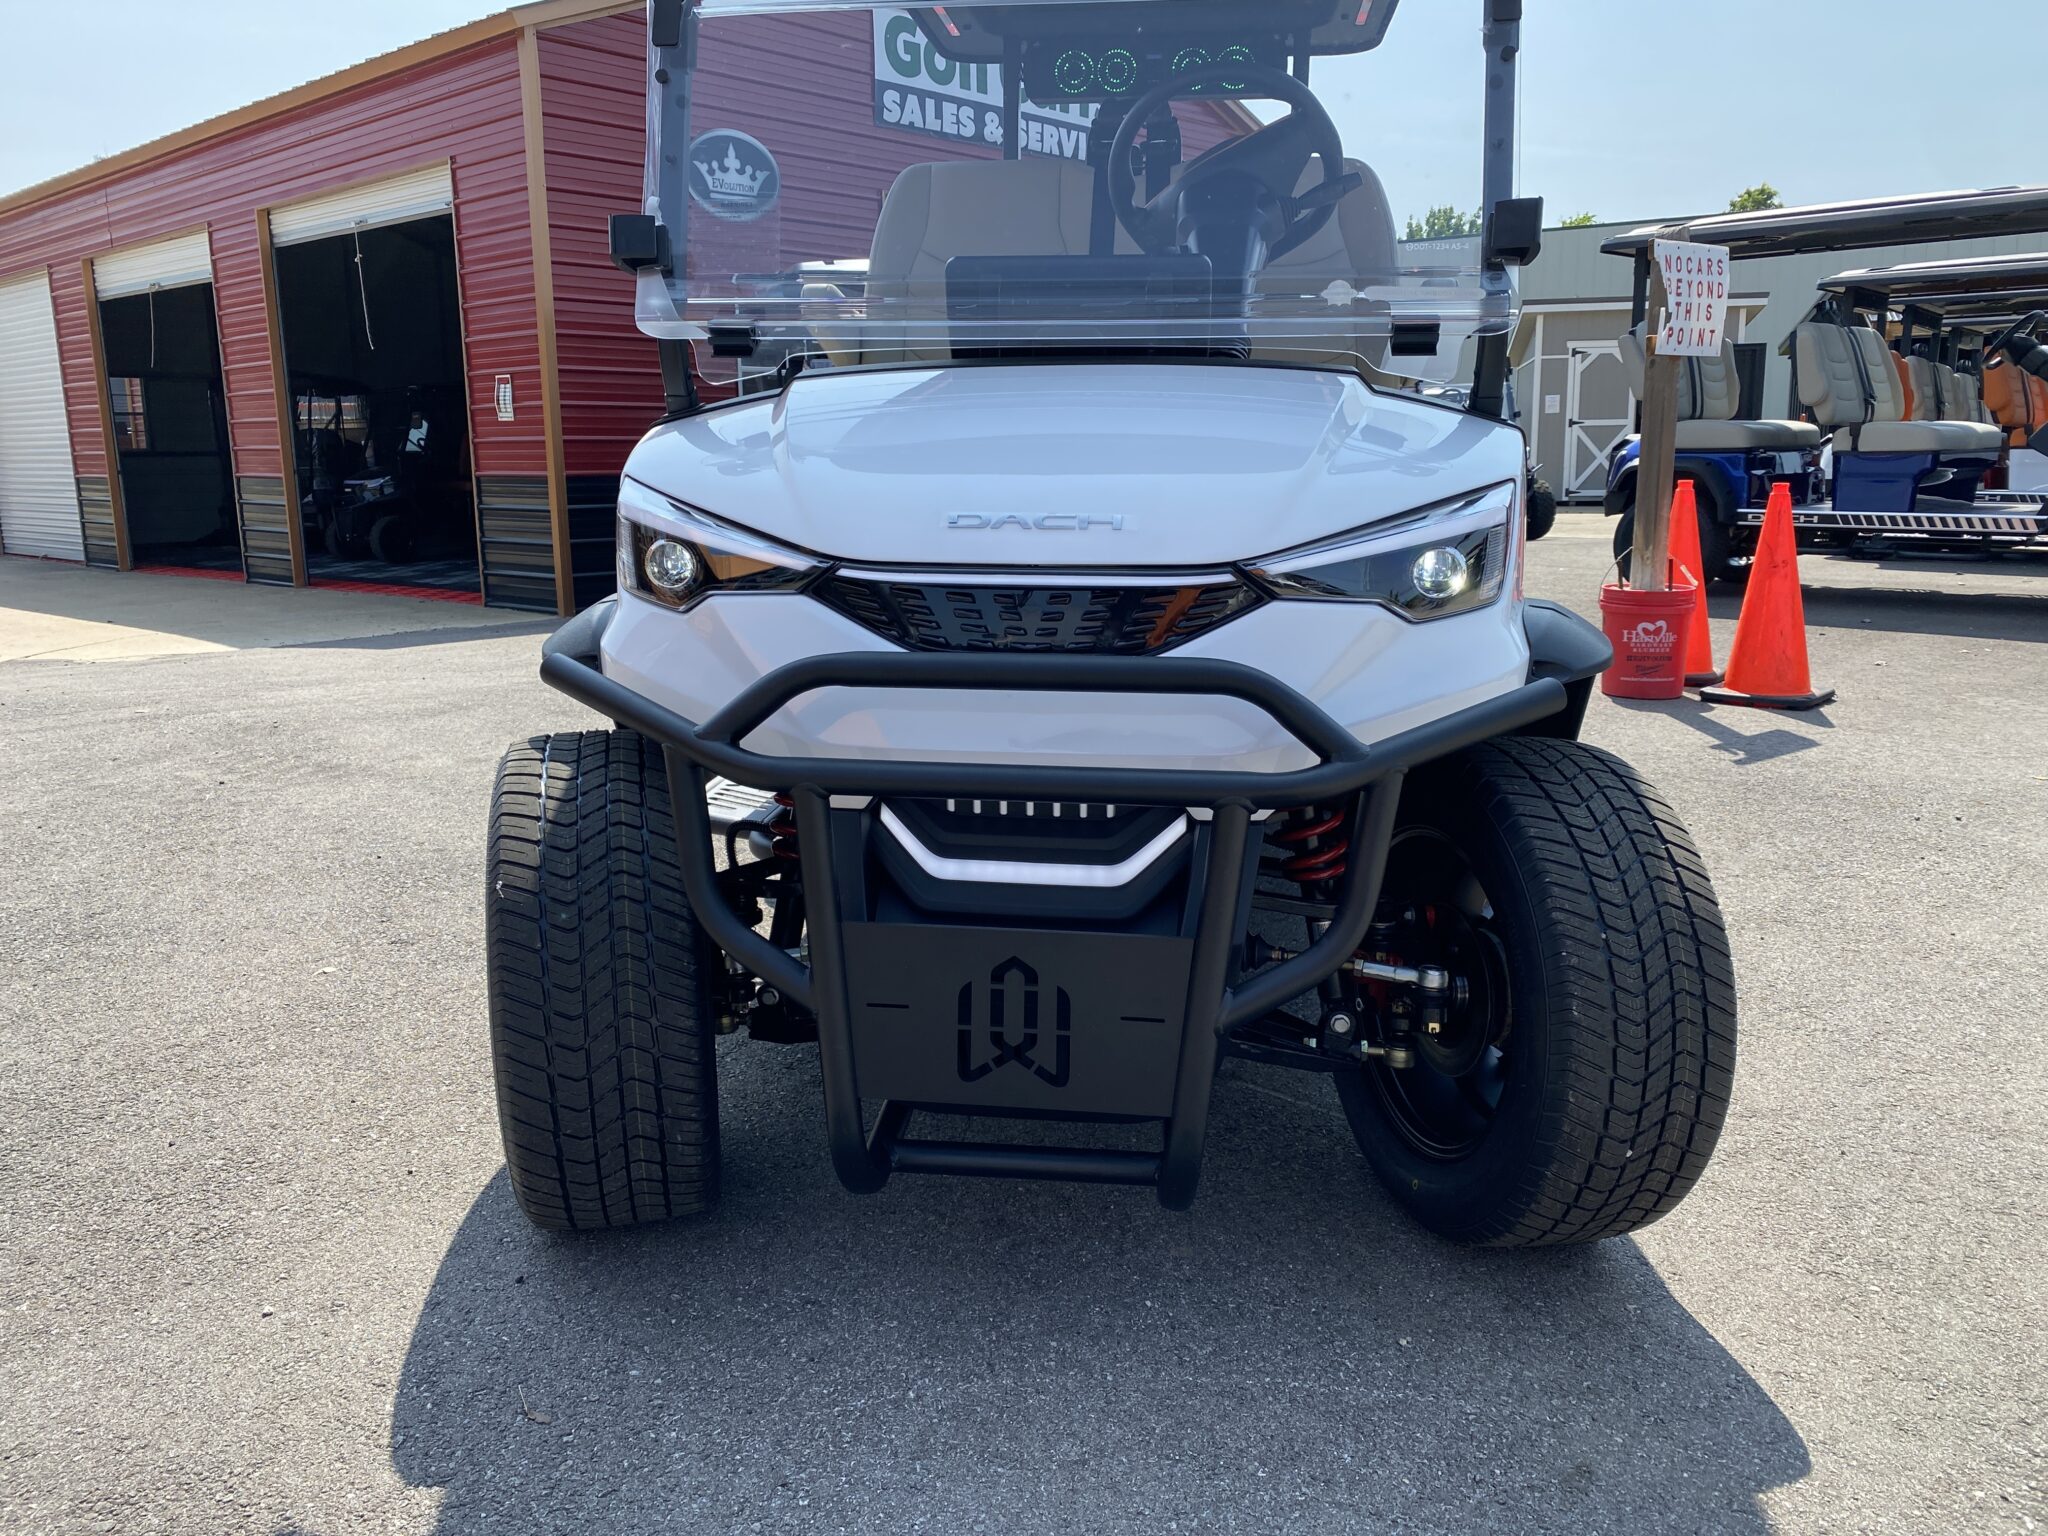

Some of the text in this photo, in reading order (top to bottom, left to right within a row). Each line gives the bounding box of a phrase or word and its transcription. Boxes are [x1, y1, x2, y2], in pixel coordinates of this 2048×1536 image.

[883, 89, 976, 138] SALES
[983, 111, 1004, 145] &
[1019, 118, 1087, 161] SERVI
[1666, 277, 1724, 300] BEYOND
[1675, 301, 1713, 322] THIS
[1666, 326, 1716, 347] POINT
[948, 514, 1124, 531] DACH
